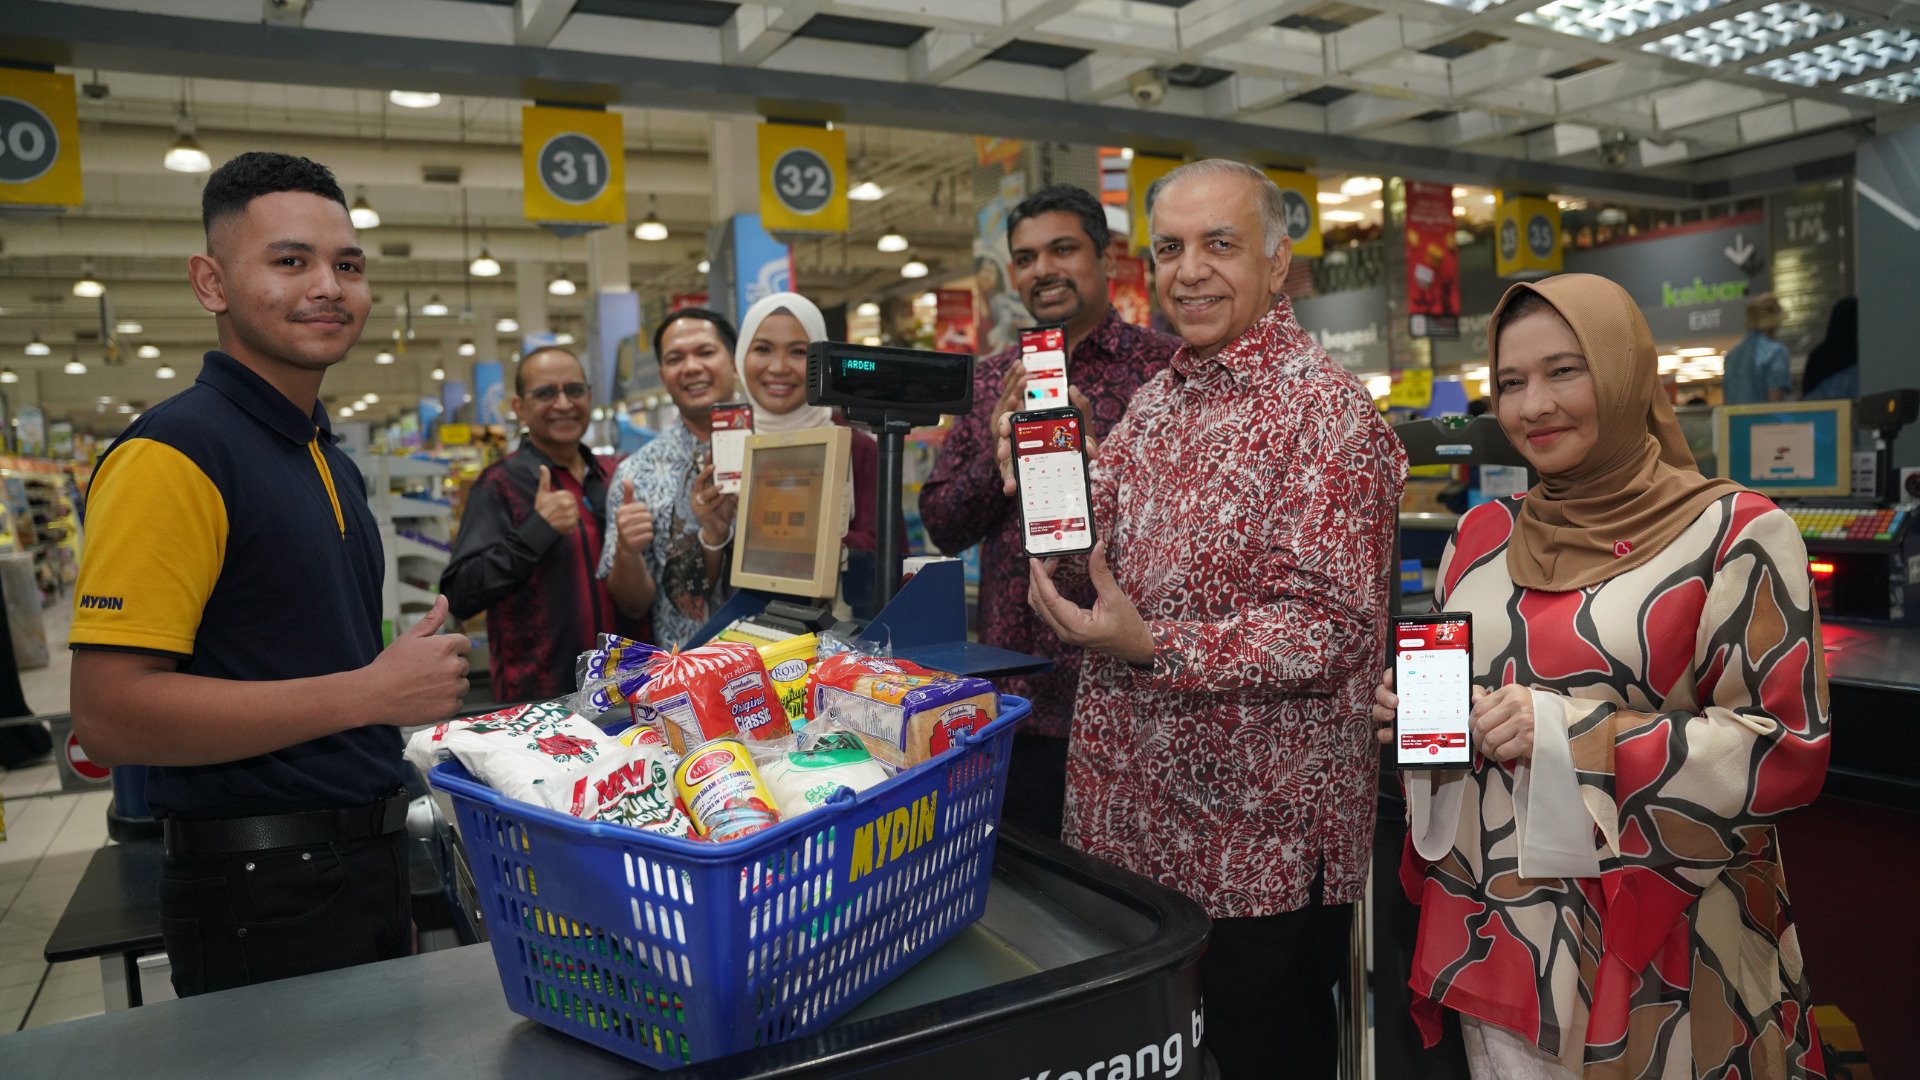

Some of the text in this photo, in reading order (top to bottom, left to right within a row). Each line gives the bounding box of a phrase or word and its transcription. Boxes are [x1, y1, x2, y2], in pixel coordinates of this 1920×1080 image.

[0, 121, 46, 161] 0
[551, 151, 597, 186] 31
[782, 165, 827, 198] 32
[1530, 223, 1551, 248] 35
[1662, 277, 1747, 308] keluar
[1688, 308, 1722, 330] EXIT
[80, 595, 123, 610] MYDIN
[774, 663, 804, 679] ROYAL
[732, 692, 766, 716] Original
[734, 706, 772, 732] Classic
[947, 721, 974, 738] Oriinal
[693, 755, 730, 777] MYRASA
[700, 780, 717, 797] DALAM
[717, 774, 729, 785] SOS
[729, 770, 752, 779] TOMATO
[805, 781, 836, 801] GULA
[849, 789, 938, 883] MYDIN
[1020, 1033, 1182, 1080] rang
